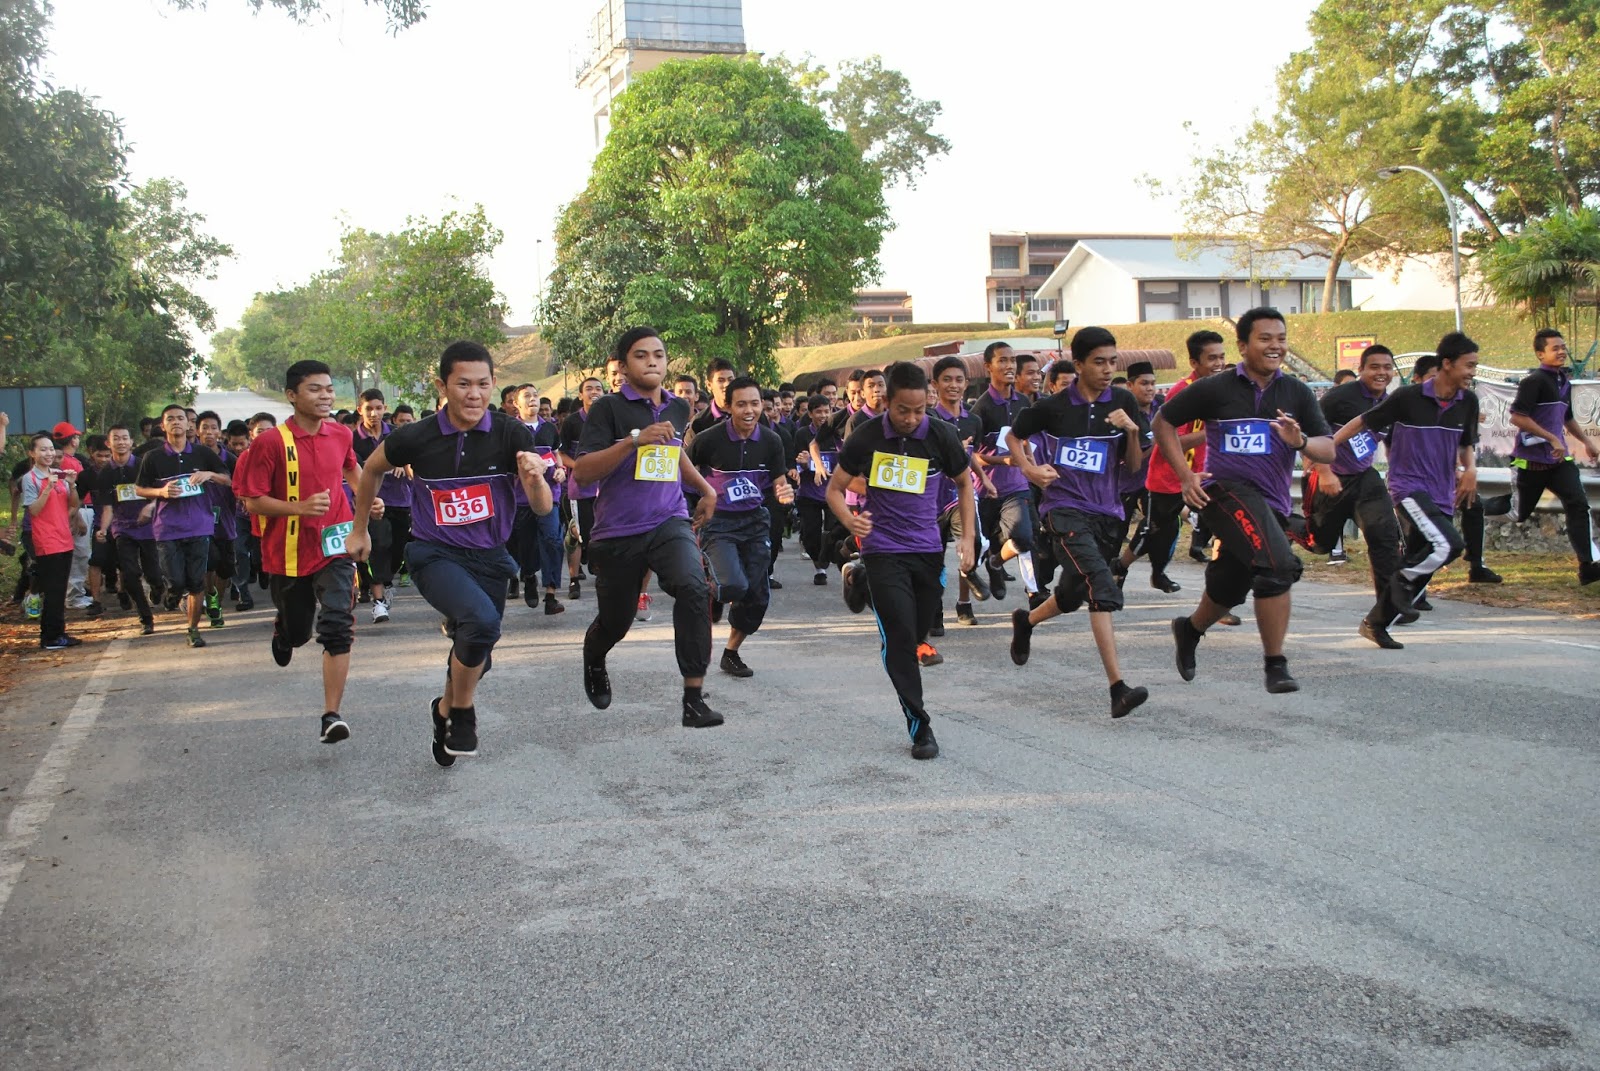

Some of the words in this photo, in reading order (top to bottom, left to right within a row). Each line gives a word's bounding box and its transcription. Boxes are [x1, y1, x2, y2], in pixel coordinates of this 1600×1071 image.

[1236, 425, 1250, 434] L1
[1076, 440, 1090, 451] L1
[1230, 436, 1263, 448] 074
[1352, 434, 1367, 453] 095
[655, 447, 669, 458] L1
[1067, 450, 1097, 466] 021
[893, 457, 908, 468] L1
[881, 466, 917, 486] 016
[451, 489, 468, 501] L1
[445, 499, 483, 518] 036
[336, 523, 350, 535] L1
